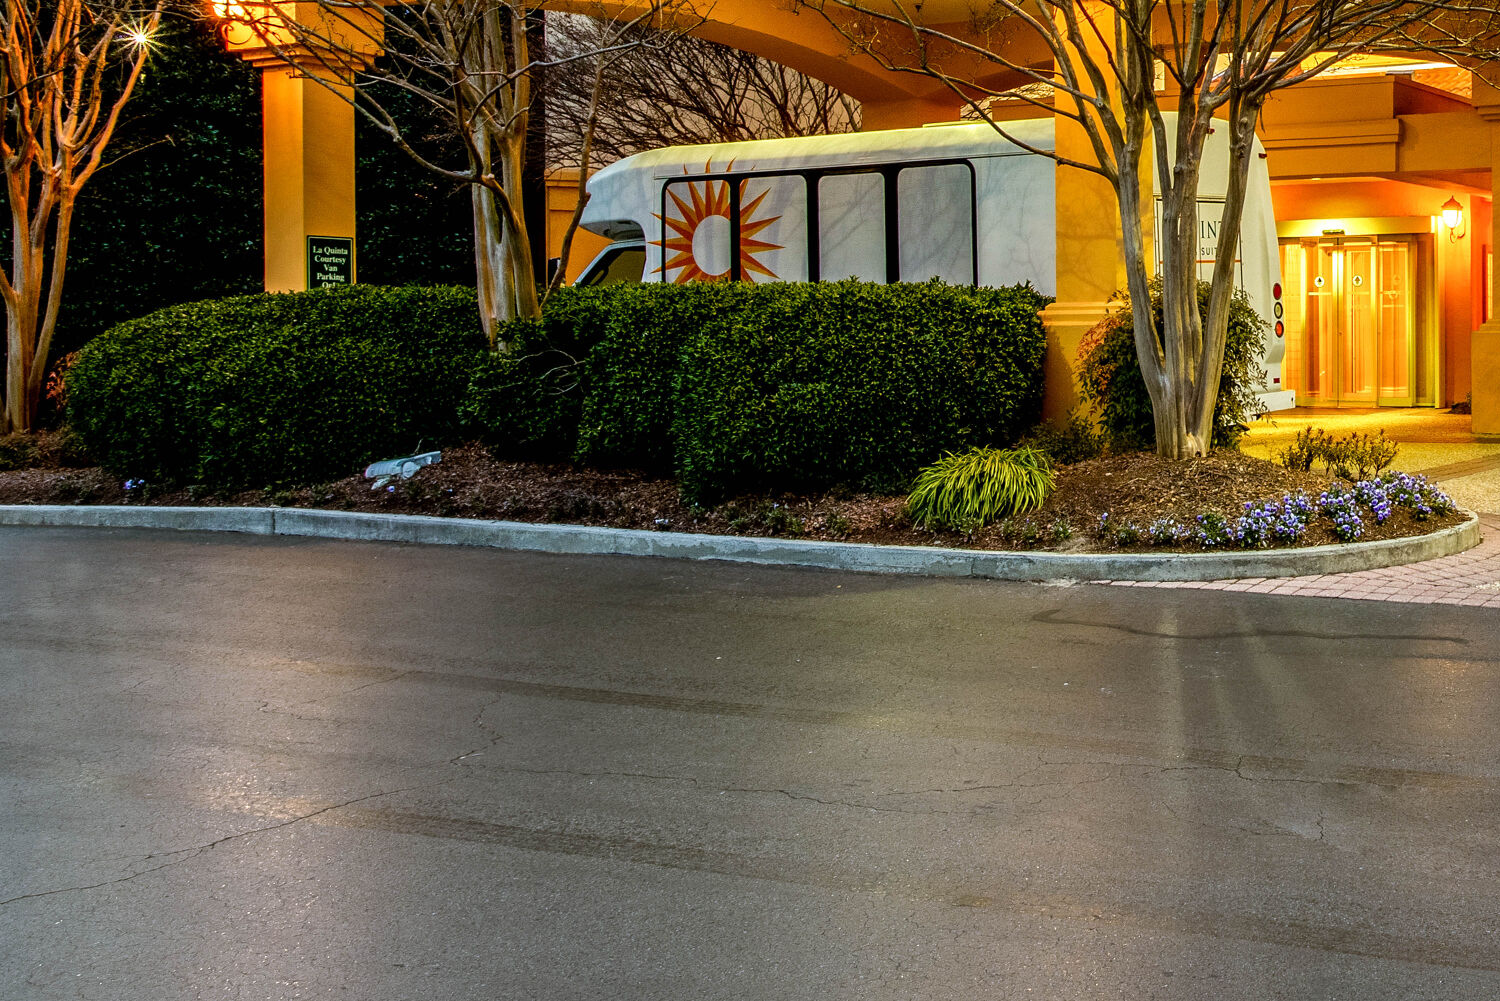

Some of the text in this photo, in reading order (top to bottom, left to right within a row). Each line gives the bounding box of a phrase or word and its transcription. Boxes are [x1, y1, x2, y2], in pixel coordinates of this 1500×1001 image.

[324, 246, 348, 255] Quinta
[314, 255, 346, 265] Courtesy
[316, 272, 345, 282] Parking
[321, 281, 337, 289] Onl
